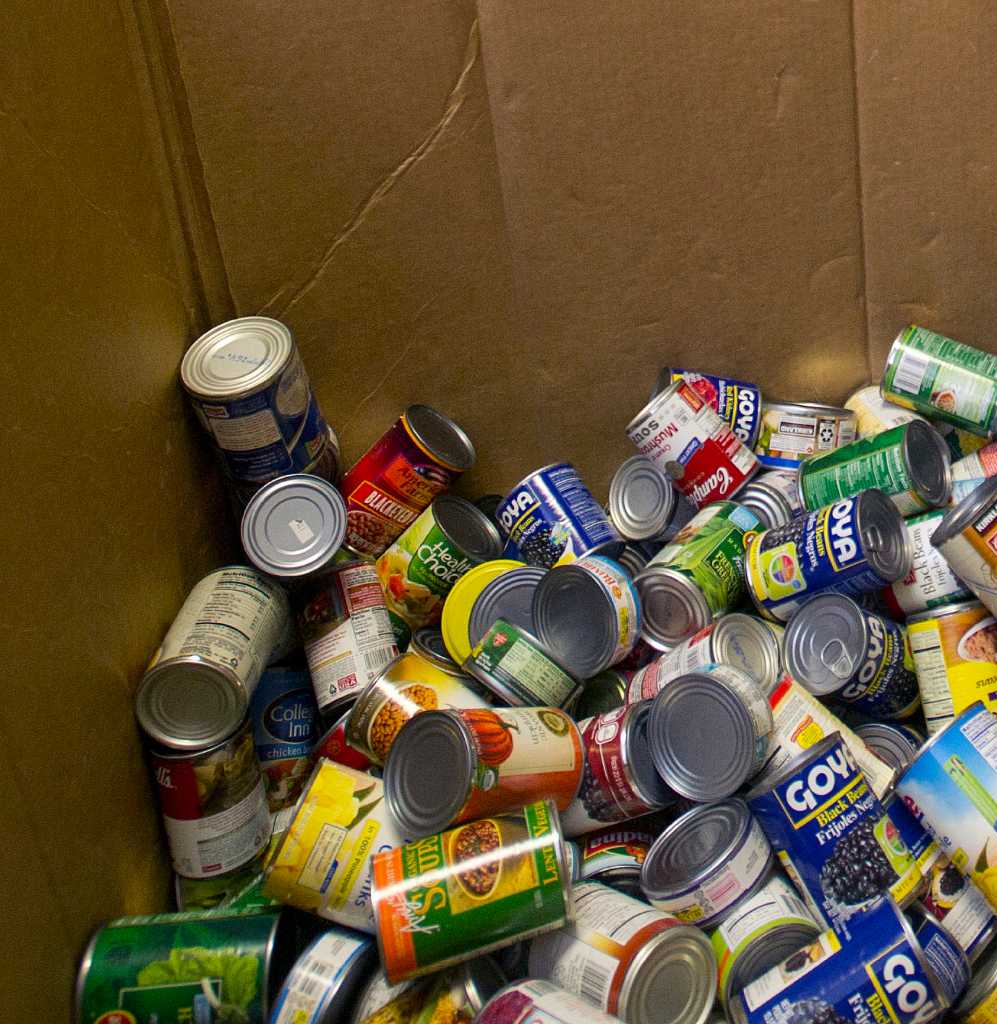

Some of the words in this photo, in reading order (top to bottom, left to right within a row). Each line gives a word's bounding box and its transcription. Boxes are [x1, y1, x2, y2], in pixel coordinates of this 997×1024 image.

[270, 703, 313, 723] Colle
[815, 798, 848, 827] Black
[815, 811, 858, 846] Frijoles
[359, 835, 372, 857] 100%
